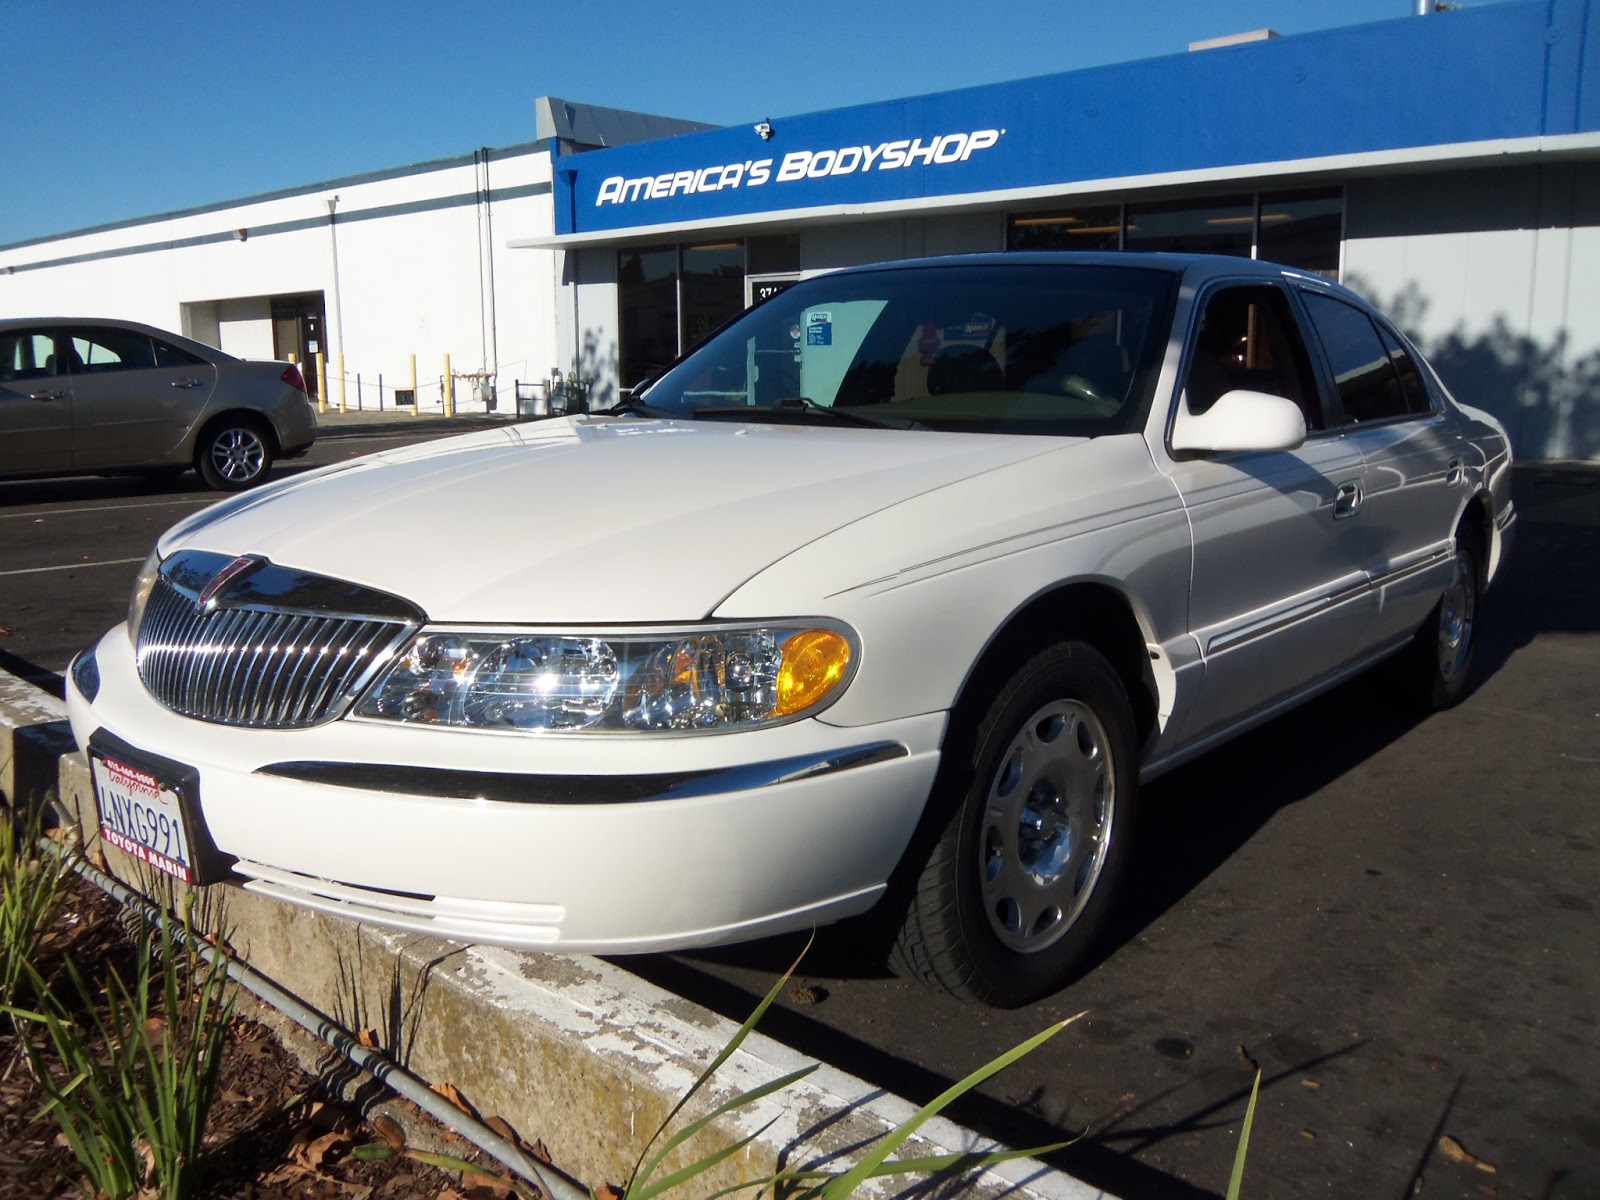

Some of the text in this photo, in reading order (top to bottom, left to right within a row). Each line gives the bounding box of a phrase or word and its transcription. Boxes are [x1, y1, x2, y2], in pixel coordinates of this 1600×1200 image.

[595, 128, 1000, 207] AMERICA'S BODYSHOP
[101, 786, 186, 867] 4NXG991
[104, 828, 188, 881] TOYOTA MARIN
